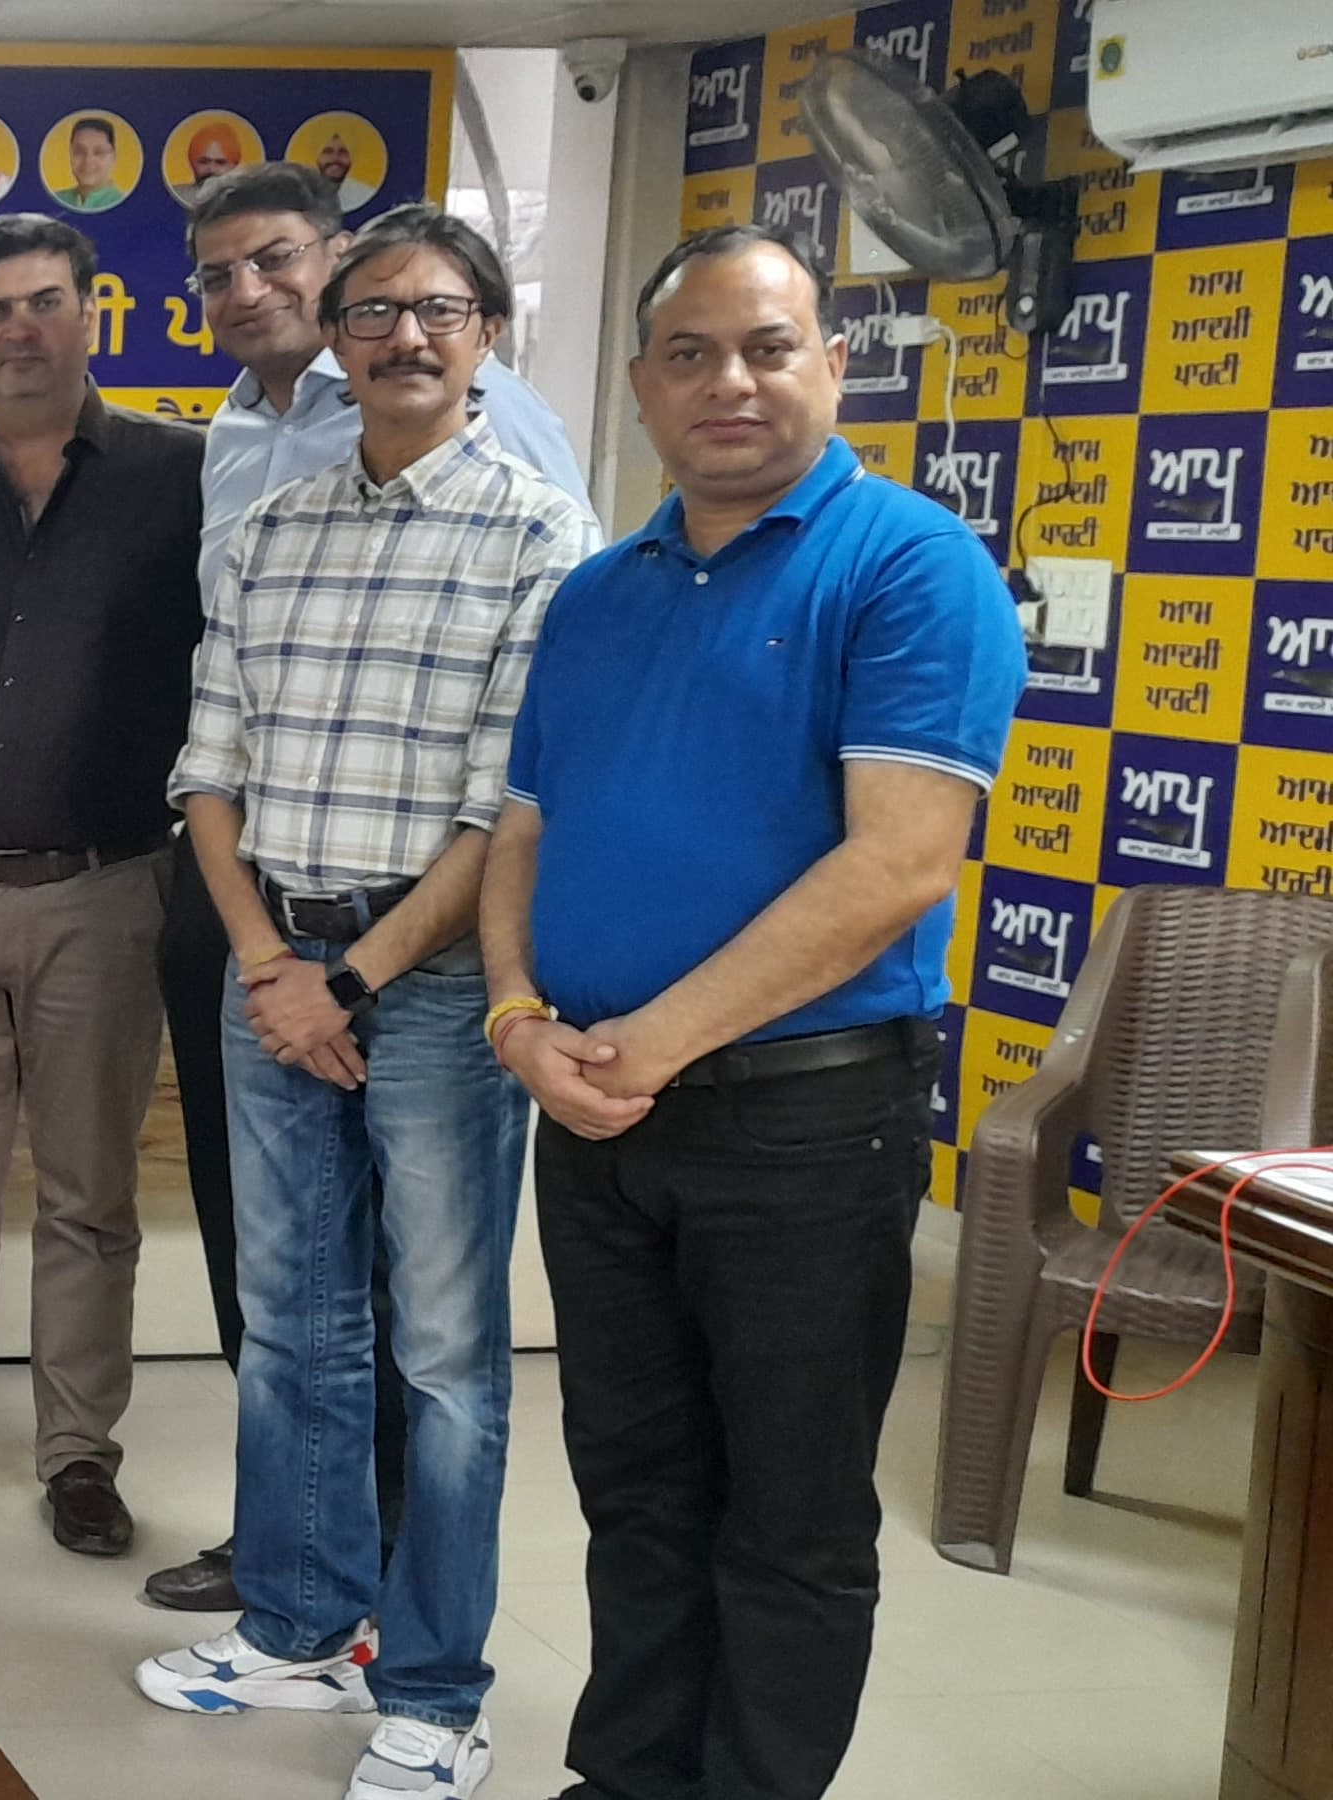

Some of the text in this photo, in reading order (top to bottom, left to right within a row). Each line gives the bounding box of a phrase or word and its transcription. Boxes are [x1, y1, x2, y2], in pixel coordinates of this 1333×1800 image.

[1189, 269, 1244, 297] ਆਮ
[1171, 305, 1252, 342] ਆਦਮੀ
[1174, 351, 1241, 387] ਪਾਰਟੀ
[924, 451, 1001, 522] ਆਪ
[1148, 447, 1244, 524] ਆਪ
[1040, 516, 1097, 547] ਪਾਰਟੀ
[1159, 599, 1213, 625] ਆਮ
[1143, 638, 1222, 670] ਆਦਮੀ
[1145, 682, 1211, 715] ਪਾਰਟੀ
[1026, 743, 1074, 771] ਆਮ
[1011, 781, 1082, 815] ਆਦਮੀ
[1121, 765, 1215, 850] ਆਪ
[1013, 823, 1071, 855] ਪਾਰਟੀ
[991, 896, 1074, 983] ਆਪ
